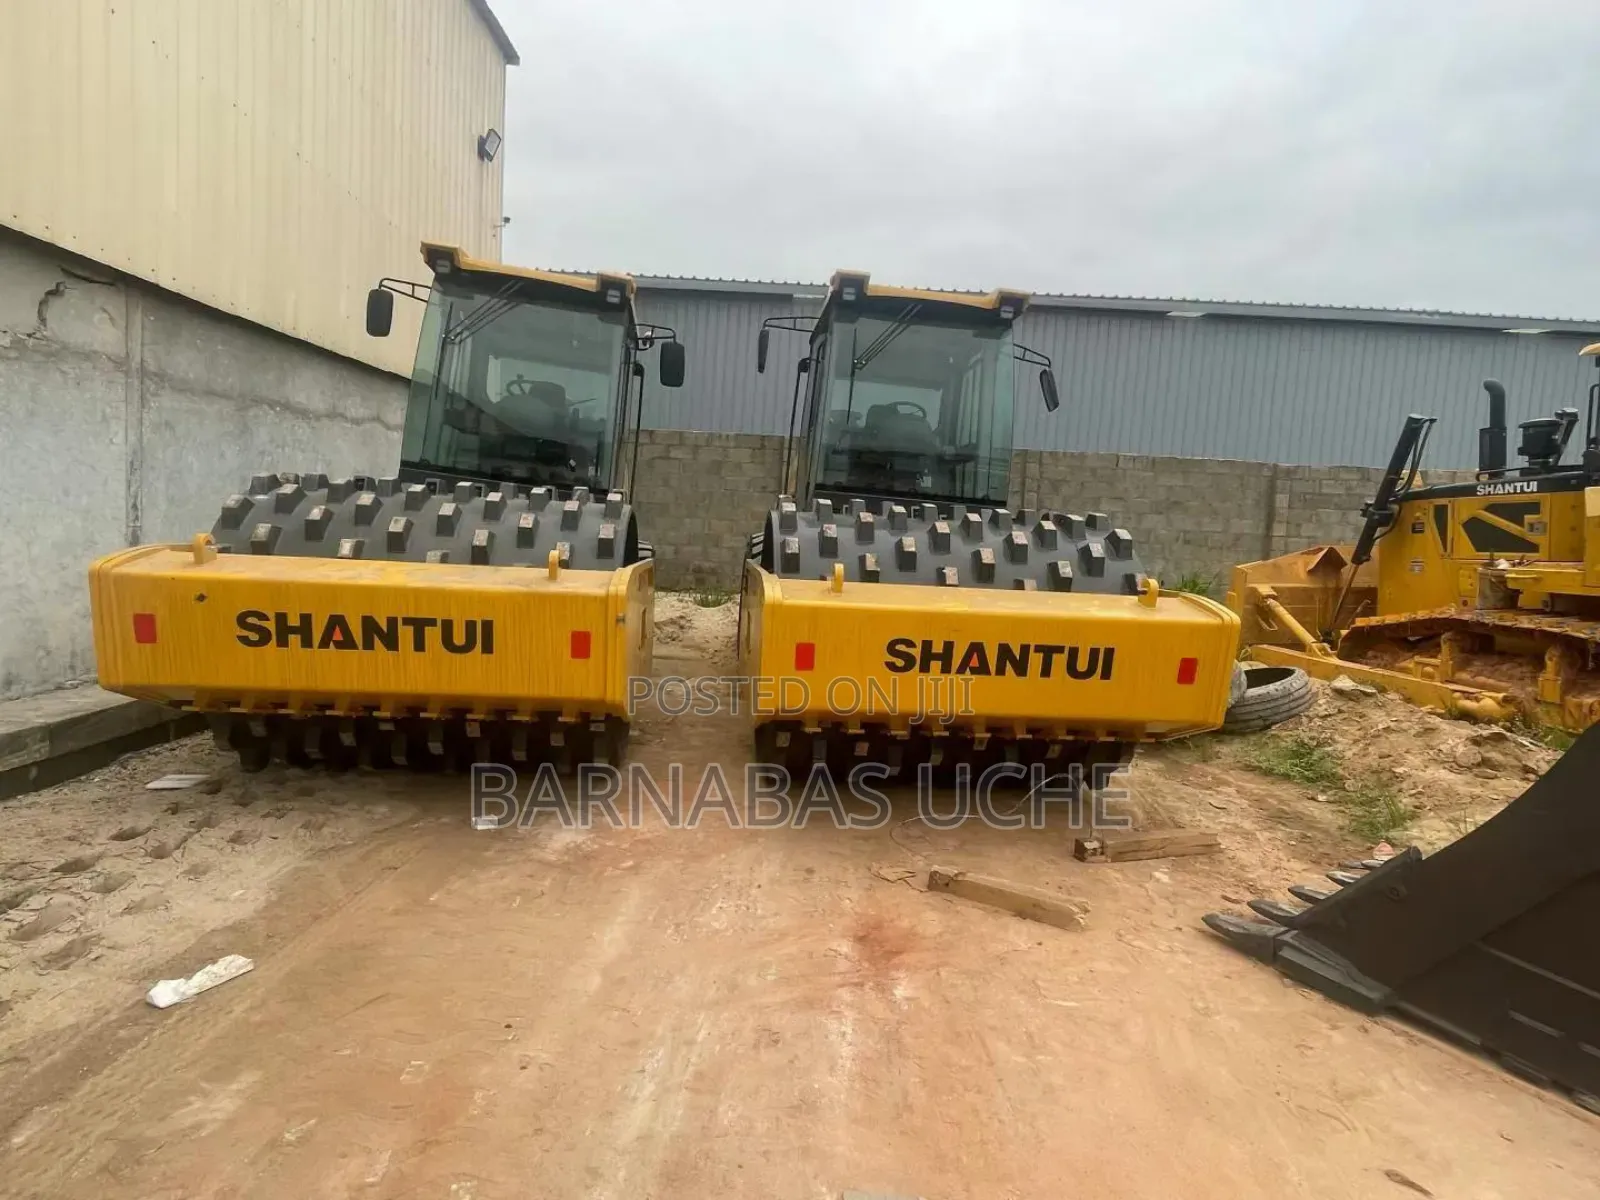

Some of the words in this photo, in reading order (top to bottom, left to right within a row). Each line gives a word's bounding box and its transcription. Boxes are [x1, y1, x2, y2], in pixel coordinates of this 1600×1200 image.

[1476, 481, 1538, 496] SHANTUI
[235, 609, 495, 655] SHANTUI
[883, 637, 1116, 681] SHANTUI
